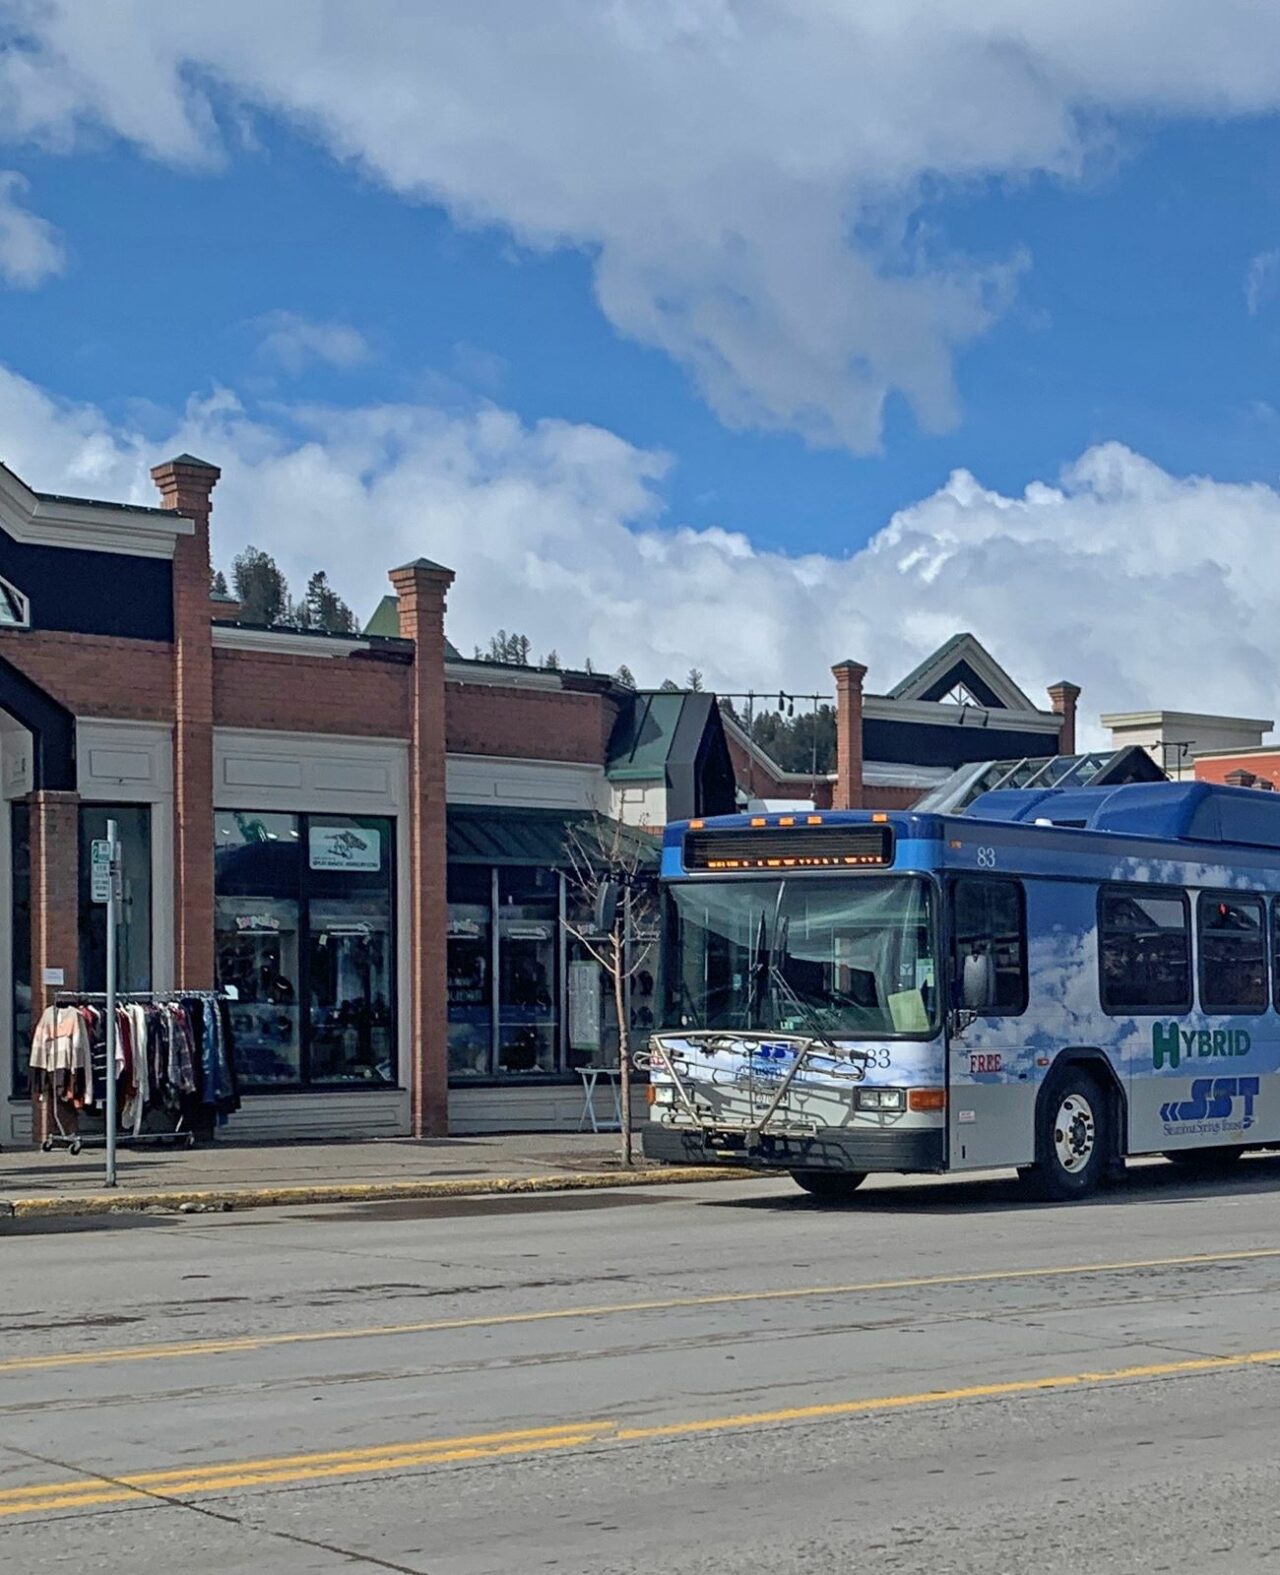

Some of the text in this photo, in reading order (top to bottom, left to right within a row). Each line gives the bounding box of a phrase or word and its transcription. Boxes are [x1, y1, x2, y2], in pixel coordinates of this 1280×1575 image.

[977, 846, 996, 868] 83
[865, 1048, 891, 1069] 83
[970, 1054, 1002, 1073] FREE
[1177, 1076, 1260, 1120] SST
